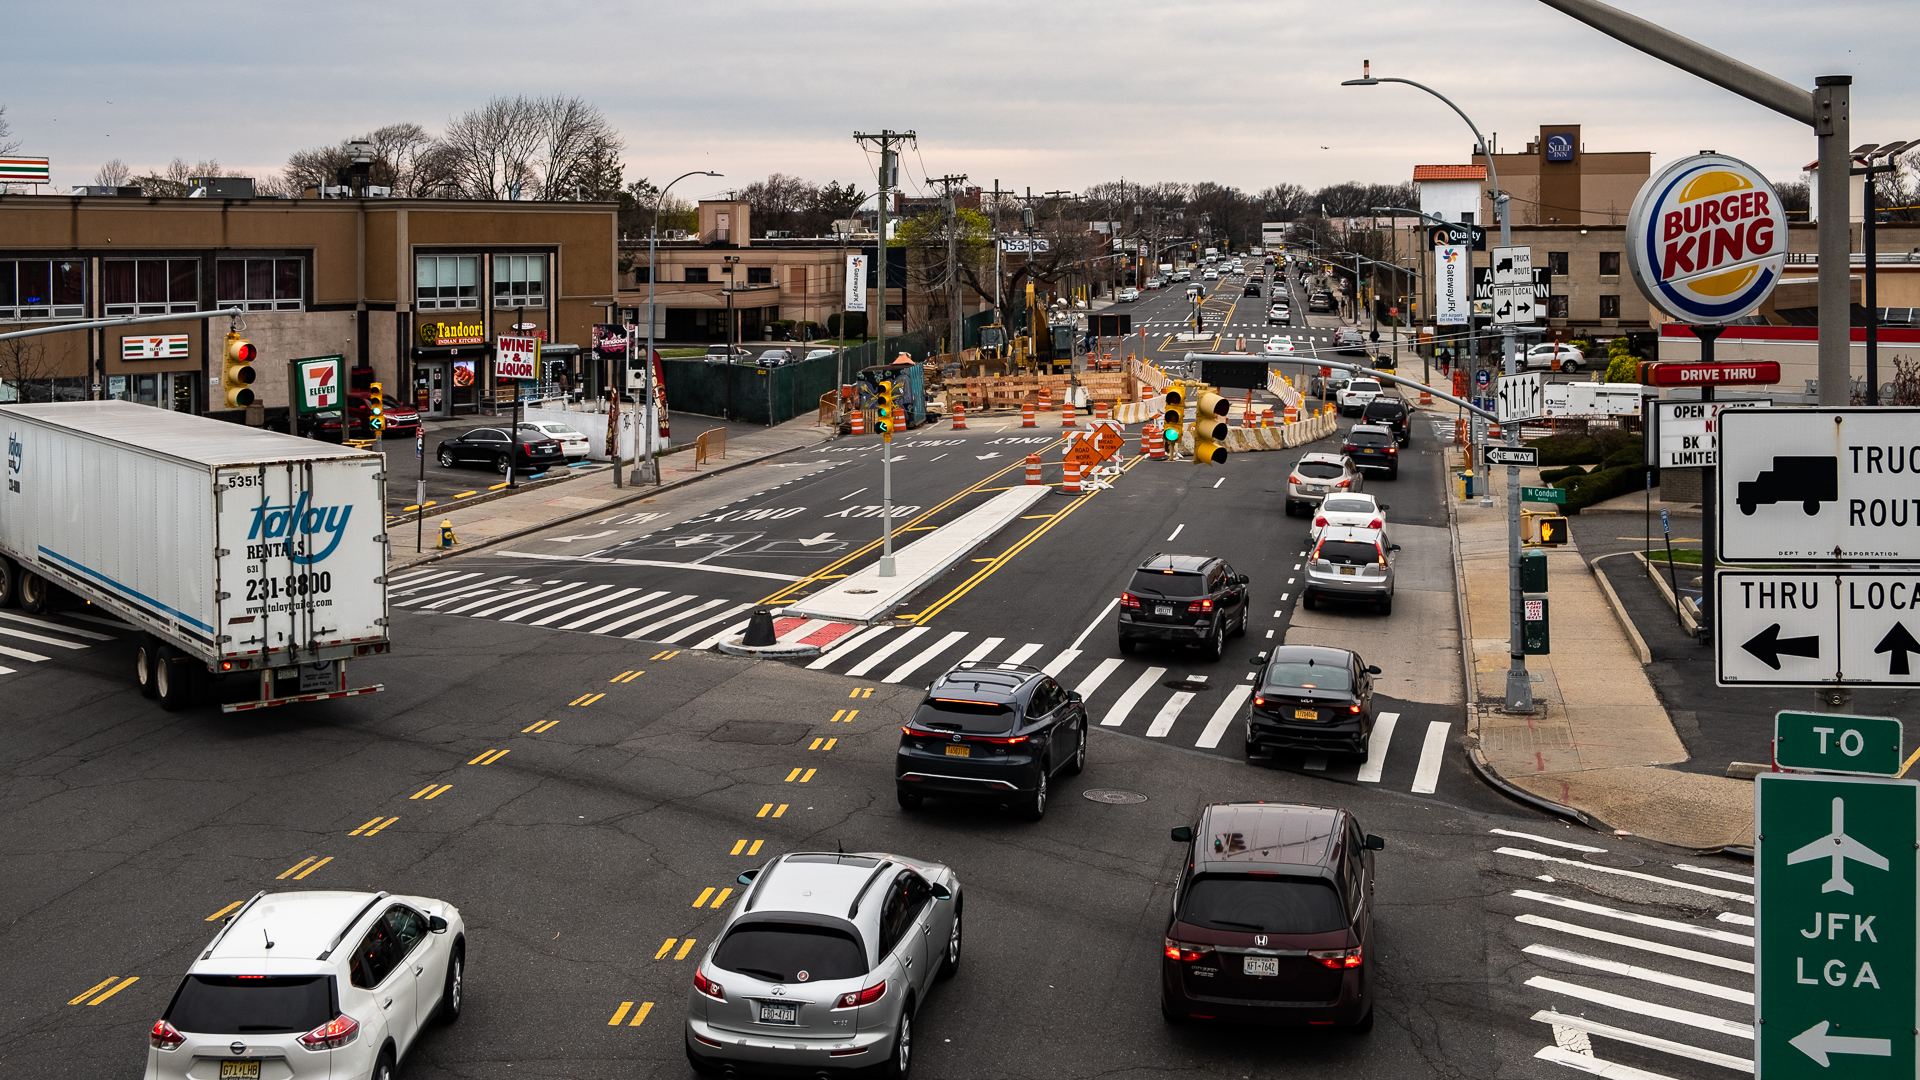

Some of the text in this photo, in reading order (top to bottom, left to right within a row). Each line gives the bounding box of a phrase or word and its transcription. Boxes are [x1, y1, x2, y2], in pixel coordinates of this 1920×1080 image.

[1664, 191, 1770, 243] BURGER
[1450, 230, 1481, 241] Quaty
[1662, 217, 1775, 280] KING
[1514, 254, 1529, 262] TRUCK
[1514, 267, 1530, 275] ROUTE
[1446, 264, 1456, 312] GatewayJFK
[1515, 287, 1532, 295] LOCAL
[437, 320, 483, 337] Tandoori
[150, 338, 163, 356] 7
[500, 338, 533, 352] WINE
[512, 353, 521, 362] &
[497, 362, 532, 376] LIQUOR
[1680, 368, 1756, 381] DRIVE THRU
[309, 365, 335, 407] 7 ELEVEN
[1673, 405, 1705, 418] OPEN
[984, 437, 1053, 445] ONLY
[1682, 436, 1699, 449] BK
[1513, 453, 1531, 461] WAY
[229, 475, 264, 488] 53513
[1535, 488, 1558, 498] Conduit
[690, 506, 807, 524] ONLY
[823, 505, 921, 518] ONLY
[247, 490, 354, 565] talay
[247, 540, 305, 560] RENTALS
[246, 565, 259, 574] 631
[246, 571, 331, 601] 231-8800
[1740, 582, 1818, 609] THRU
[246, 598, 333, 615] www.talaytrailer.com
[1813, 726, 1864, 757] TO
[1800, 911, 1878, 943] JFK
[1797, 956, 1881, 989] LGA
